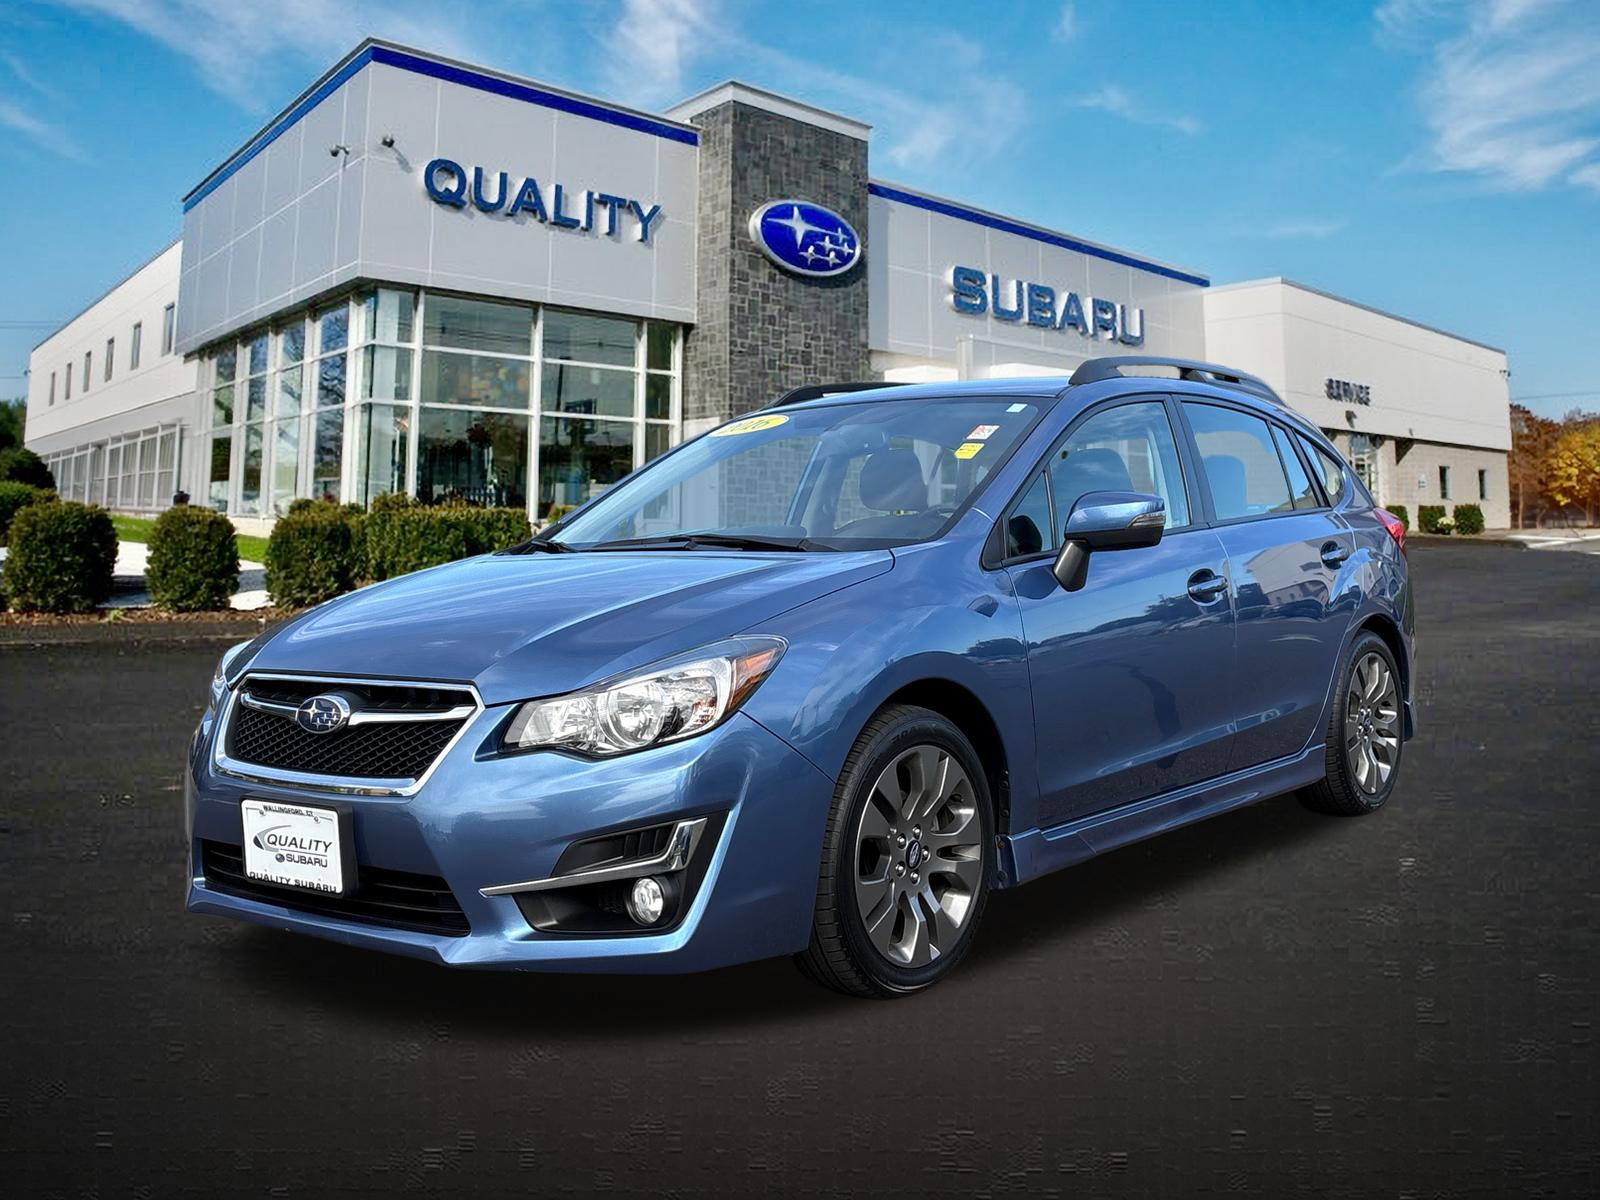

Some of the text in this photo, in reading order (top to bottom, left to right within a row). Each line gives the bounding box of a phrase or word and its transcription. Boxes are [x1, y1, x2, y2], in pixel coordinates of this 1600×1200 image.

[424, 158, 662, 243] QUALITY
[949, 265, 1145, 347] SUBARU
[1325, 378, 1371, 406] SERVICE
[267, 834, 332, 853] QUALITY
[286, 853, 328, 868] SUBARU
[249, 871, 337, 893] QUALITY SUBARU
